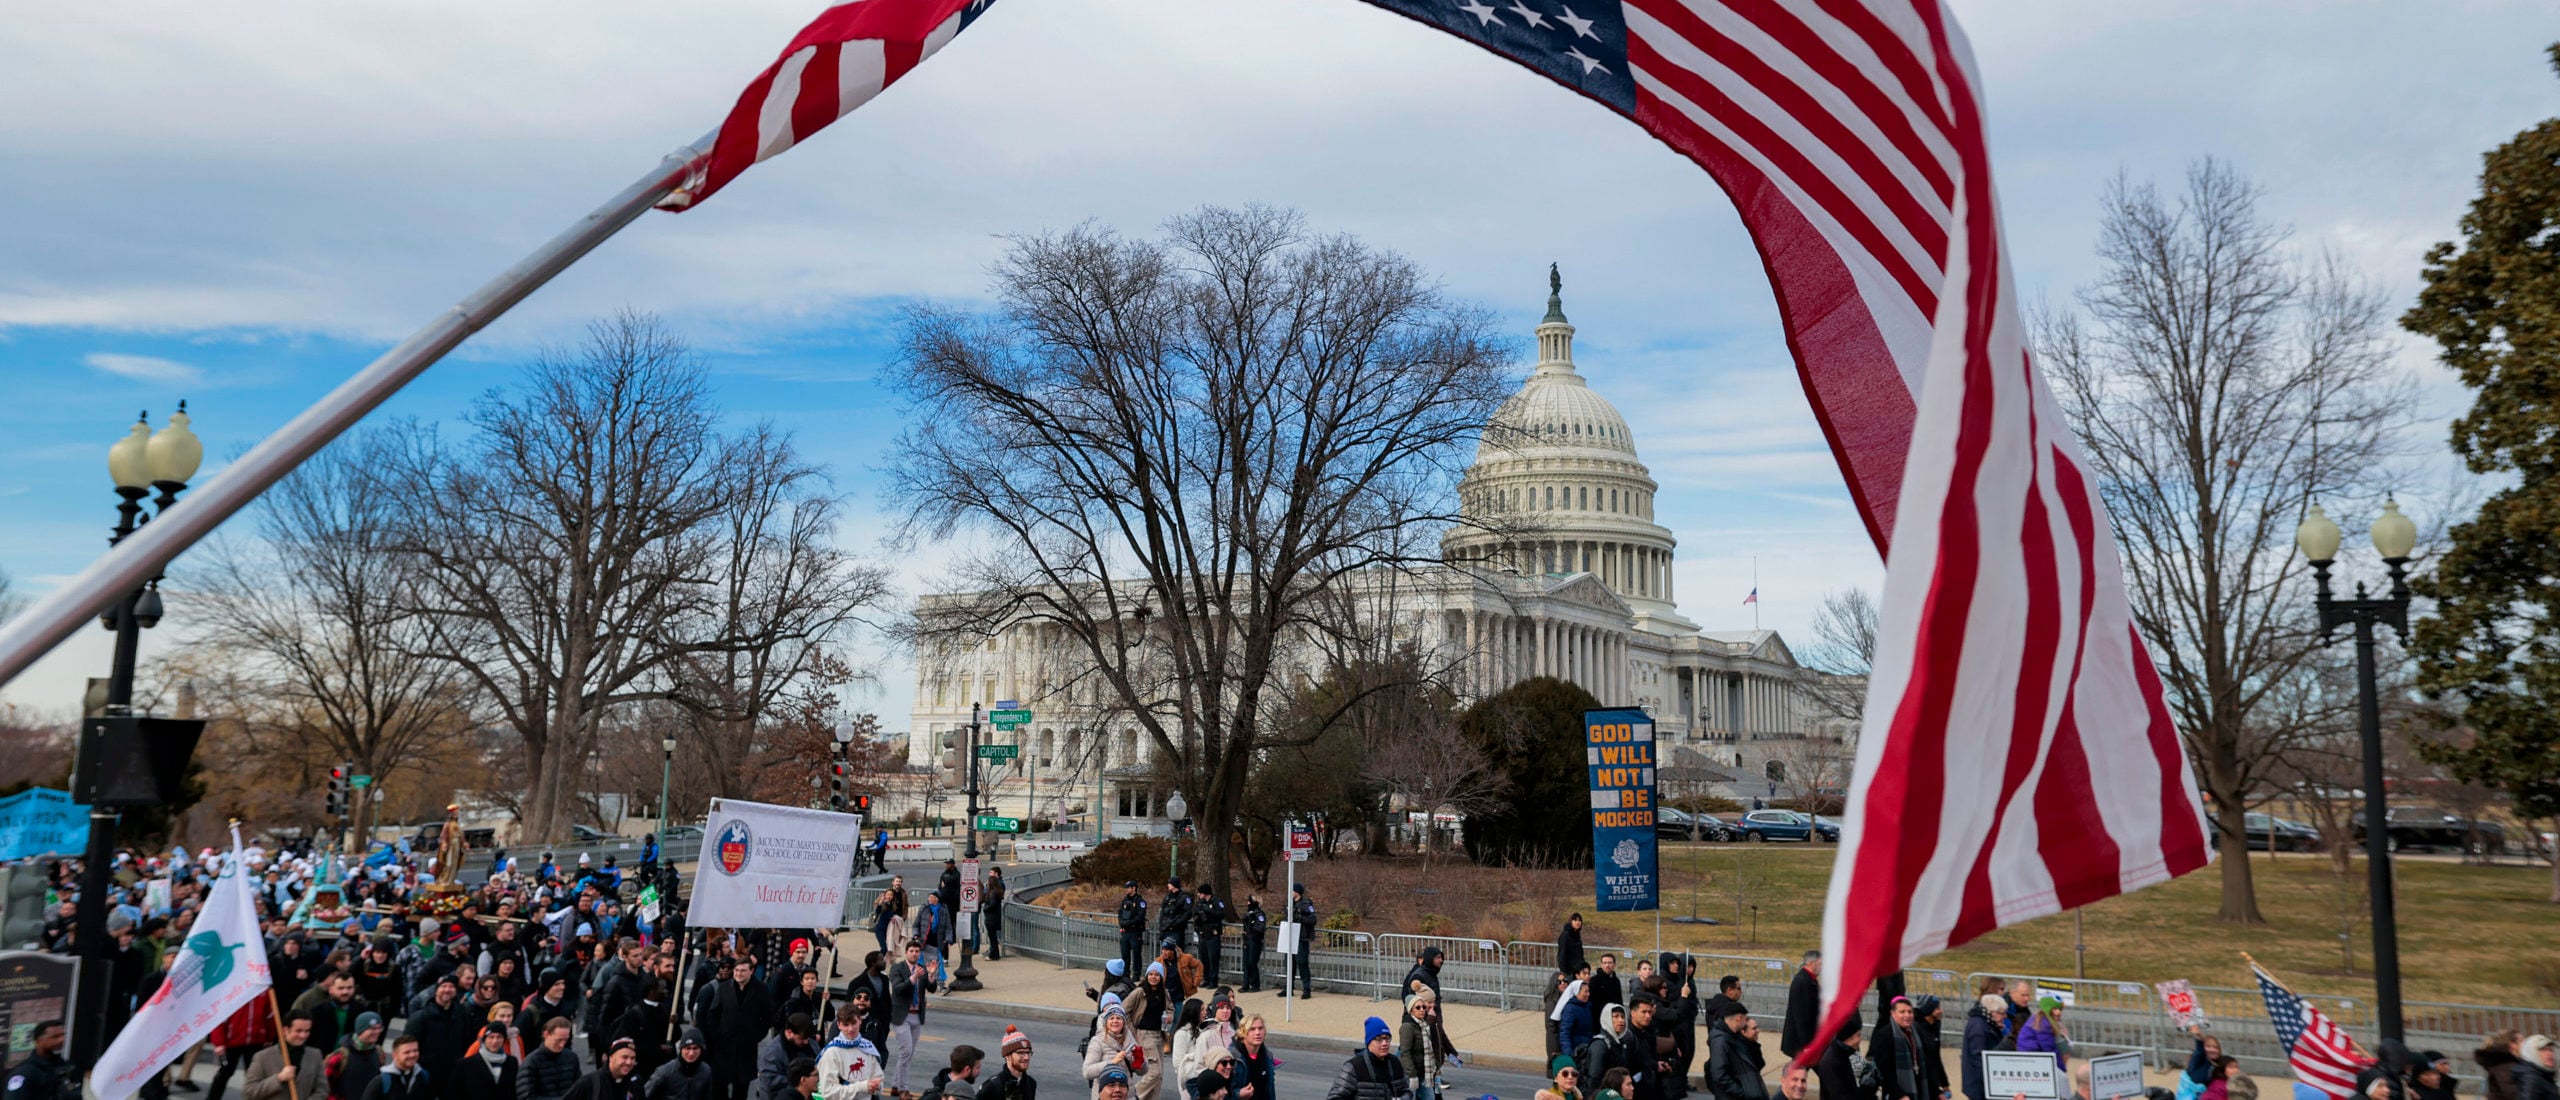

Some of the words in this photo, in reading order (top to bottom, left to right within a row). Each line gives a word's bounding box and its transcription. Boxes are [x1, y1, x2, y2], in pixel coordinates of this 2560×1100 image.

[992, 712, 1022, 723] Independence
[1589, 724, 1632, 743] GOD
[980, 747, 1010, 756] CAPITOL
[1600, 746, 1652, 764] WILL
[1597, 768, 1640, 787] NOT
[1621, 790, 1648, 808] BE
[1594, 810, 1653, 828] MOCKED
[757, 836, 786, 847] MOUNT
[764, 848, 792, 858] SCHOOL
[793, 850, 803, 860] OF
[804, 851, 838, 862] THEOLOGY
[1605, 874, 1649, 885] WHITE
[755, 884, 794, 903] March
[797, 885, 816, 904] for
[819, 886, 839, 904] Life
[1612, 885, 1644, 894] ROSE
